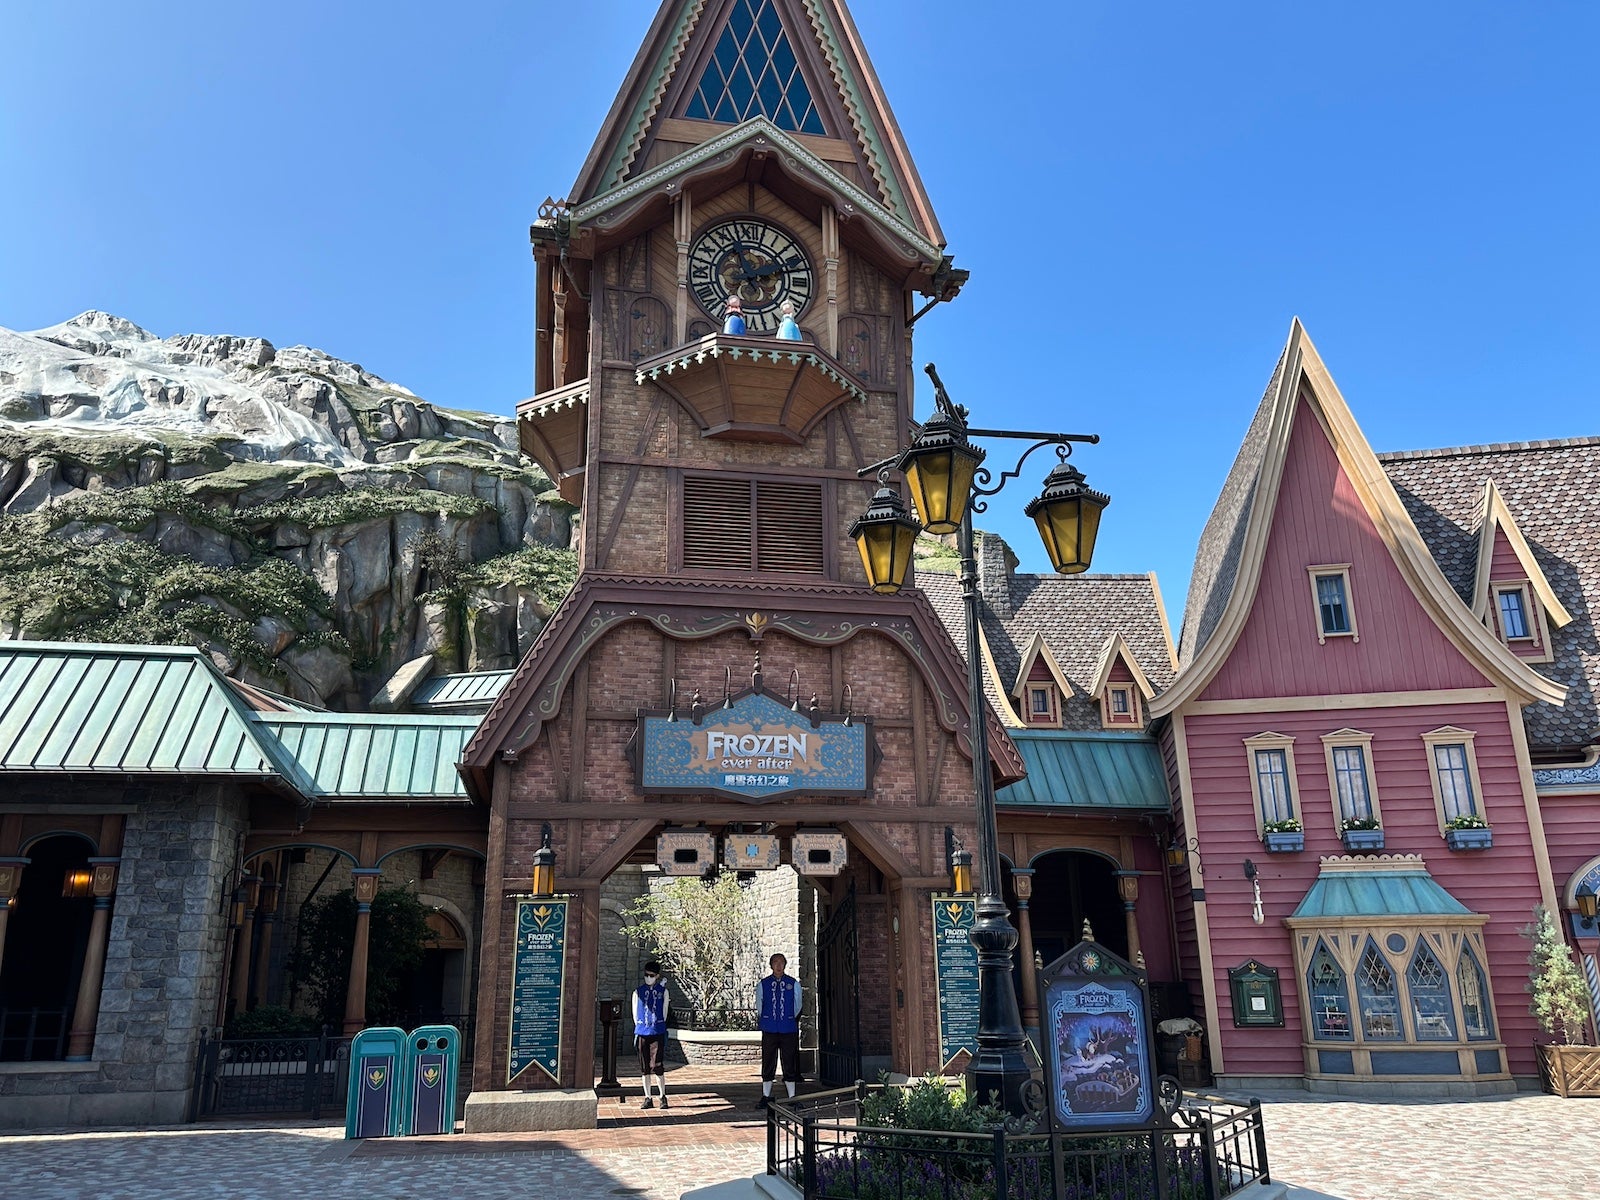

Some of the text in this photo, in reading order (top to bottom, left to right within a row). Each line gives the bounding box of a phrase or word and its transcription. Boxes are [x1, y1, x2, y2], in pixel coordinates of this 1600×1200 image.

[706, 731, 808, 763] FROZEN
[721, 757, 792, 770] ever after
[527, 933, 554, 941] FROZEN
[1080, 994, 1110, 1004] FROZEN
